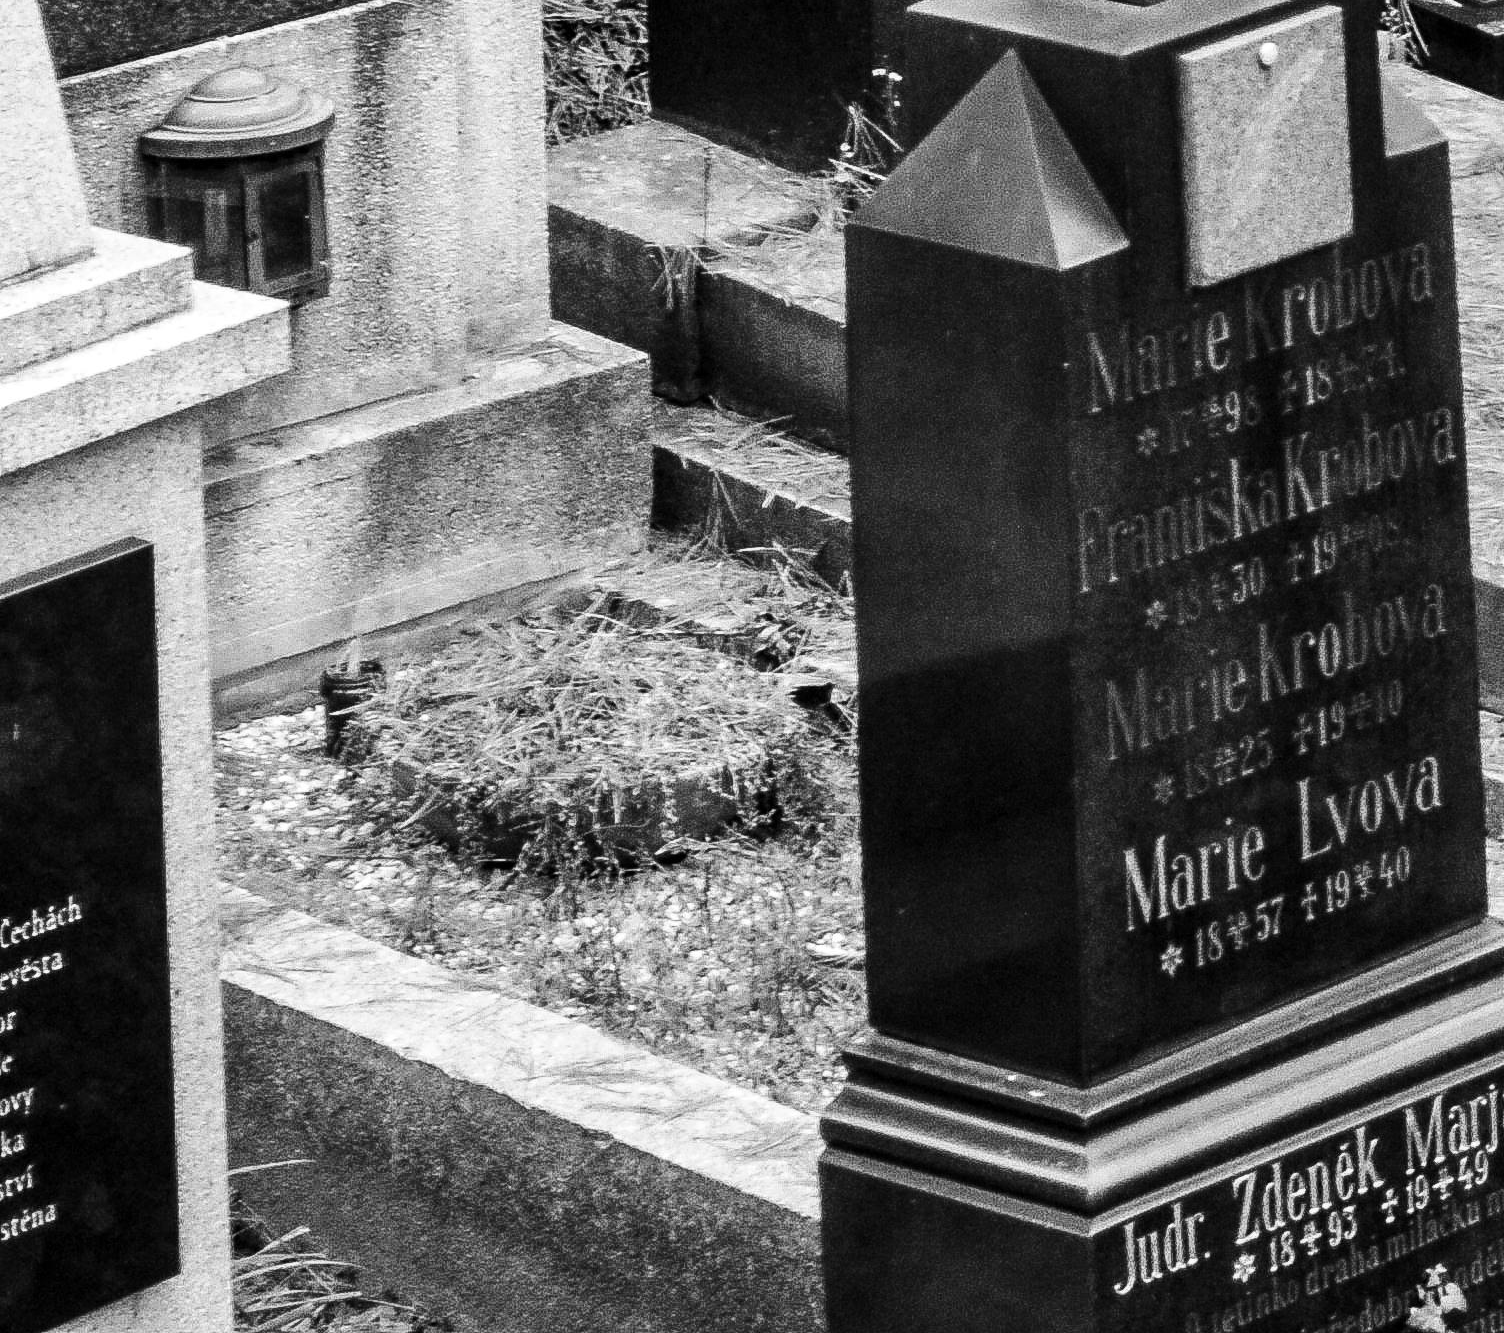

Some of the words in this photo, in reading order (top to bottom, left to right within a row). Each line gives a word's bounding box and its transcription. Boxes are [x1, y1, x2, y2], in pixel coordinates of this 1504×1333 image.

[1087, 302, 1232, 413] Marie
[1105, 647, 1248, 762] Marie
[1258, 583, 1449, 703] Krobova
[1123, 816, 1266, 933] Marie
[1297, 755, 1443, 862] Lvova
[1112, 1201, 1212, 1297] Judr.
[1232, 1125, 1385, 1246] Zdeněk
